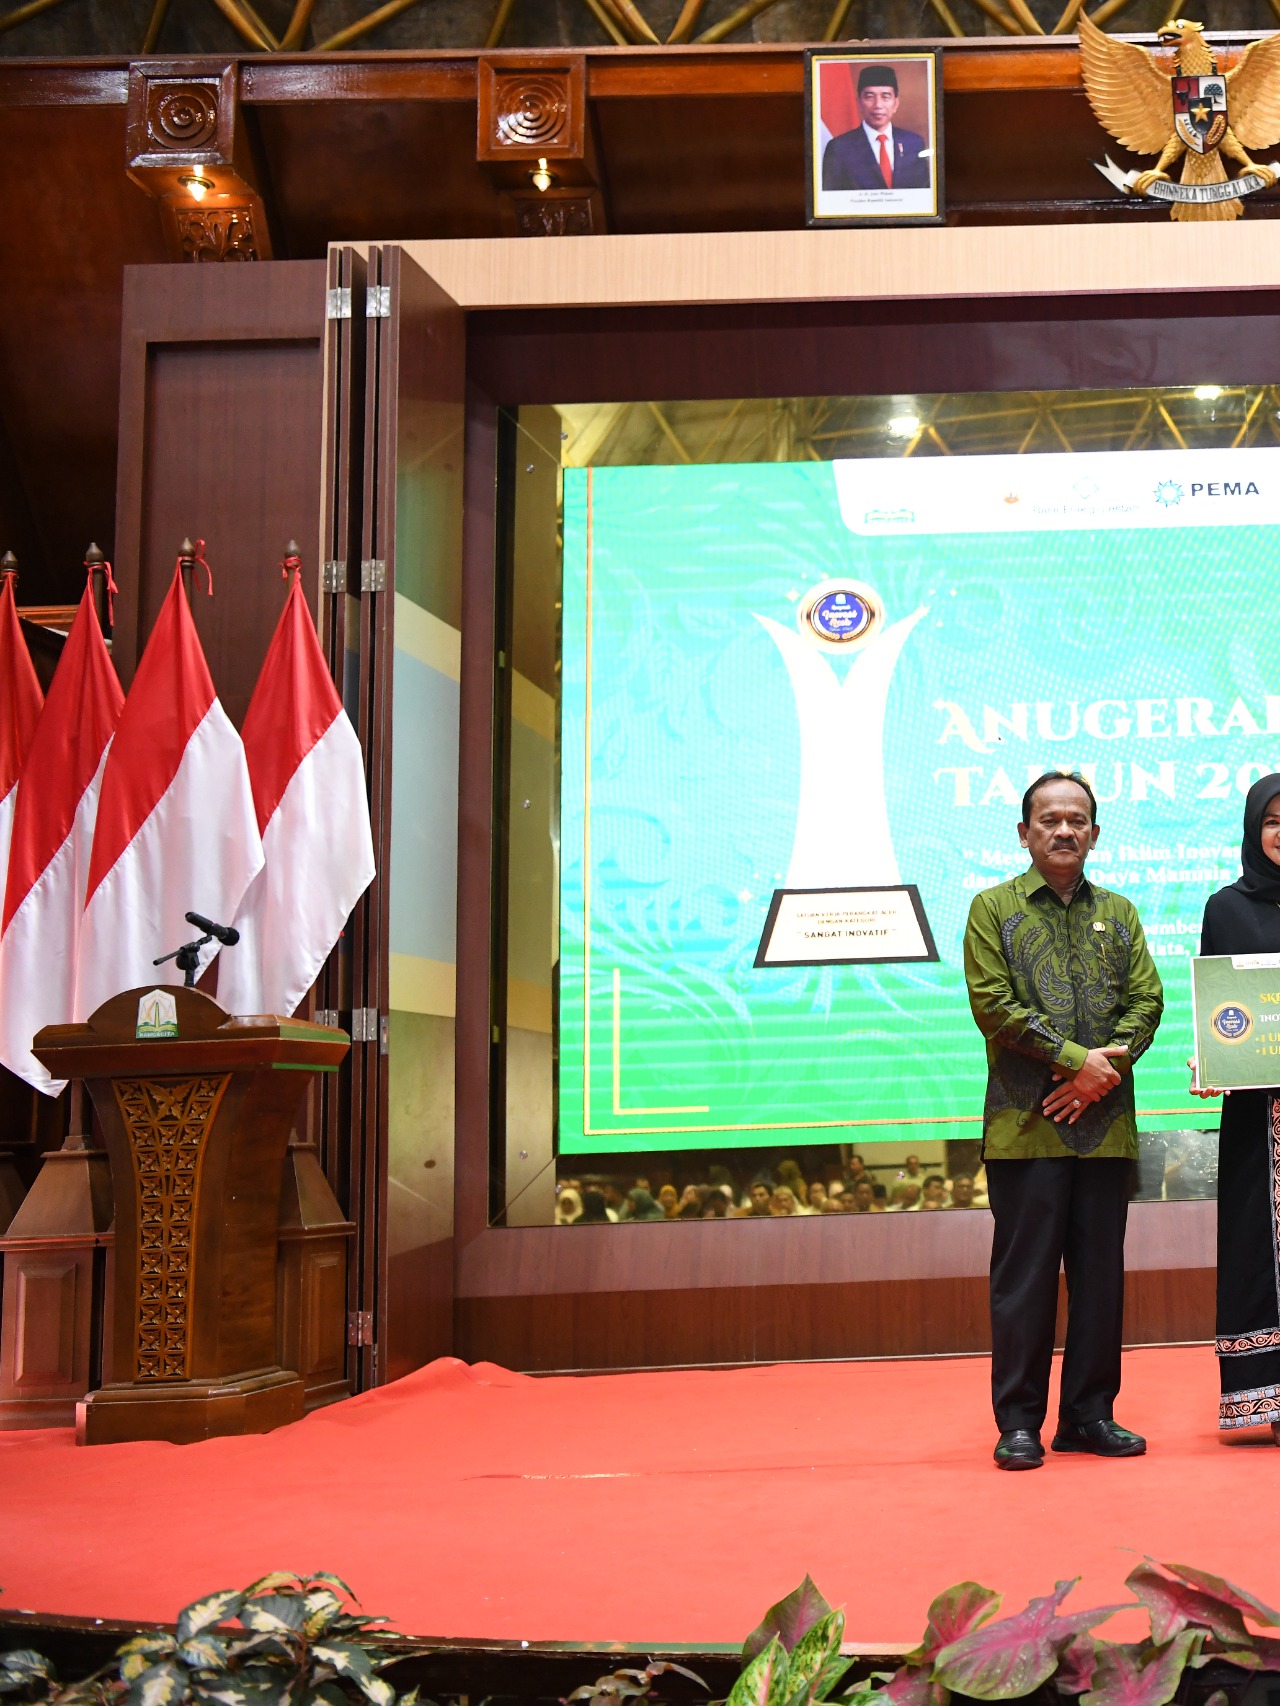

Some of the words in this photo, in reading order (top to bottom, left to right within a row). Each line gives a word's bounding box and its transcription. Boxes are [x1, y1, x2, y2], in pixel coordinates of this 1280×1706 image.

[1153, 181, 1197, 200] BHINNEKA
[1200, 181, 1245, 201] TUNGGAL
[1245, 176, 1261, 191] IKA
[1191, 482, 1260, 496] PEMA
[1089, 868, 1140, 888] Daya
[845, 929, 888, 937] INOVATIF
